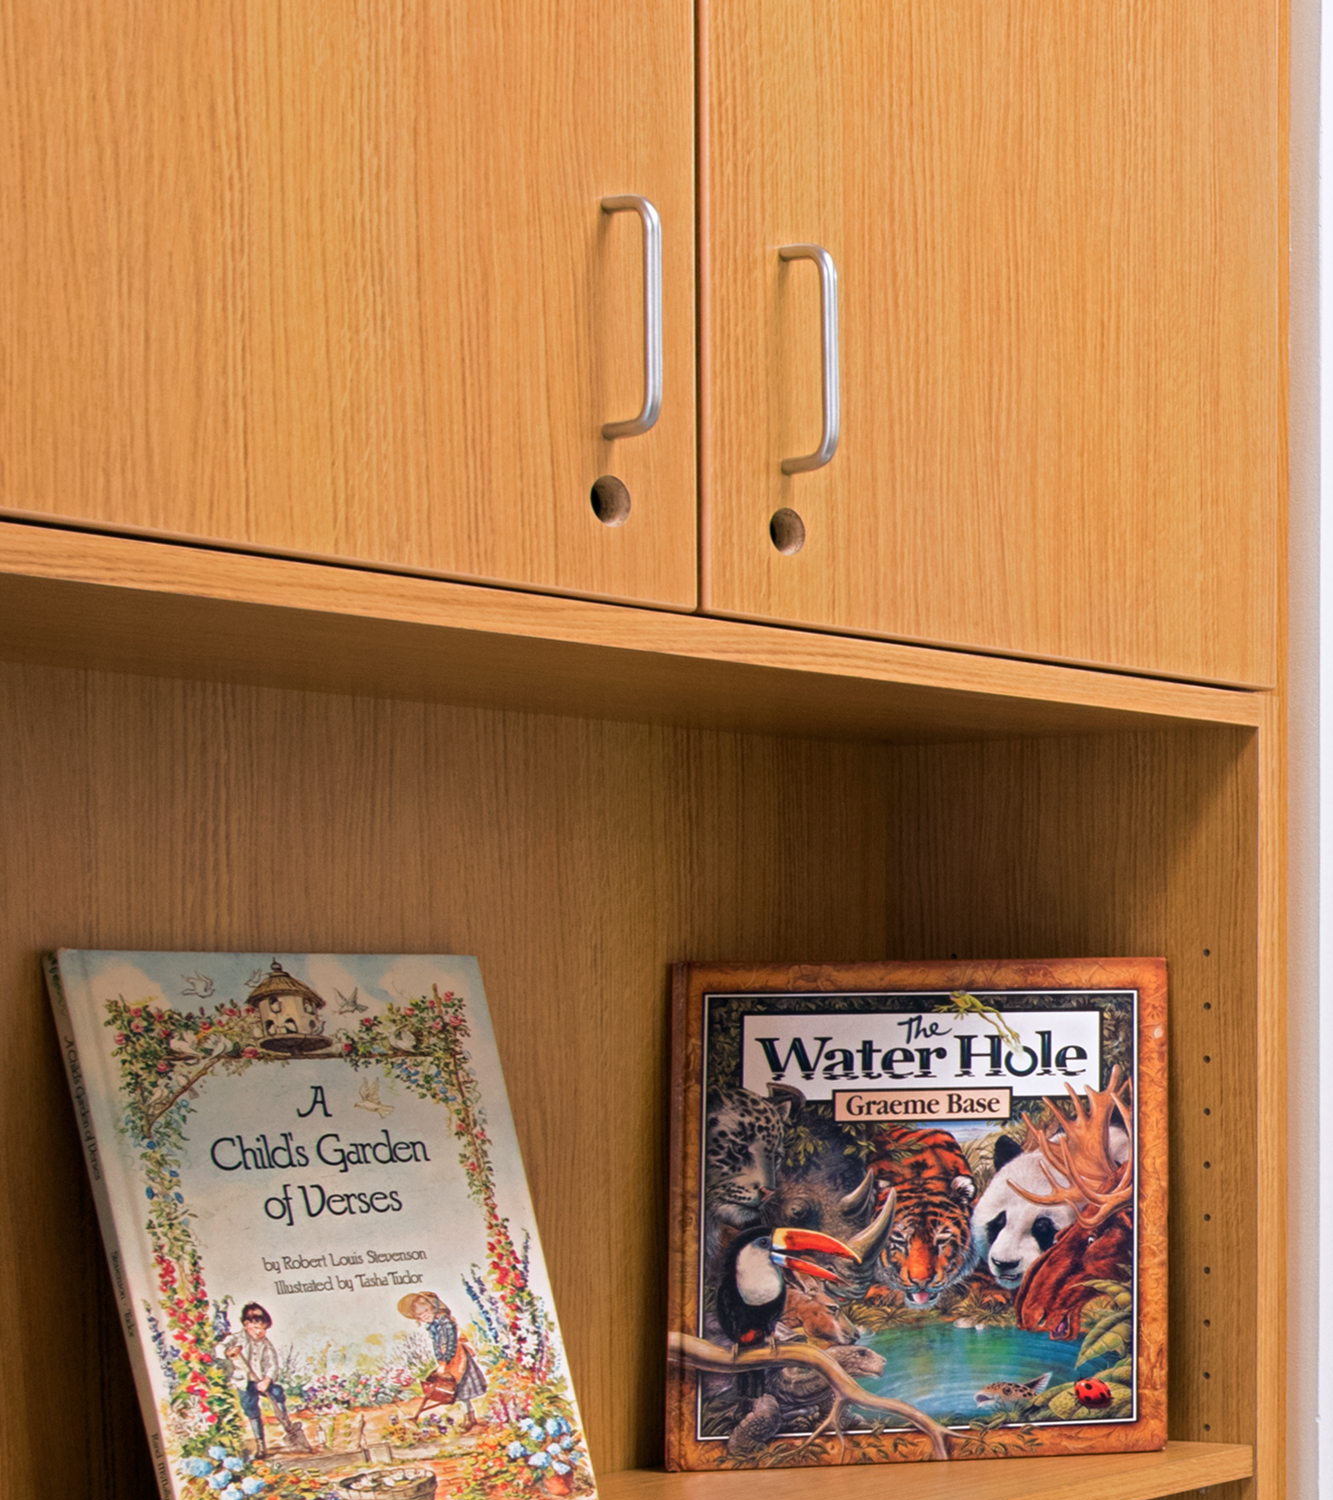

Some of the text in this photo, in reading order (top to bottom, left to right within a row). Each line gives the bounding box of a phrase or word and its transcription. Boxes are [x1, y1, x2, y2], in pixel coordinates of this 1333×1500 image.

[897, 1015, 952, 1044] The
[755, 1030, 1088, 1080] Water Hole
[297, 1086, 332, 1117] A
[845, 1093, 1000, 1116] Graeme Base
[210, 1129, 431, 1172] Child's Garden
[264, 1184, 402, 1226] of Verses
[262, 1250, 427, 1274] by Robert Louis Stevenson
[274, 1270, 423, 1295] Illustrated by Tasha Tudor
